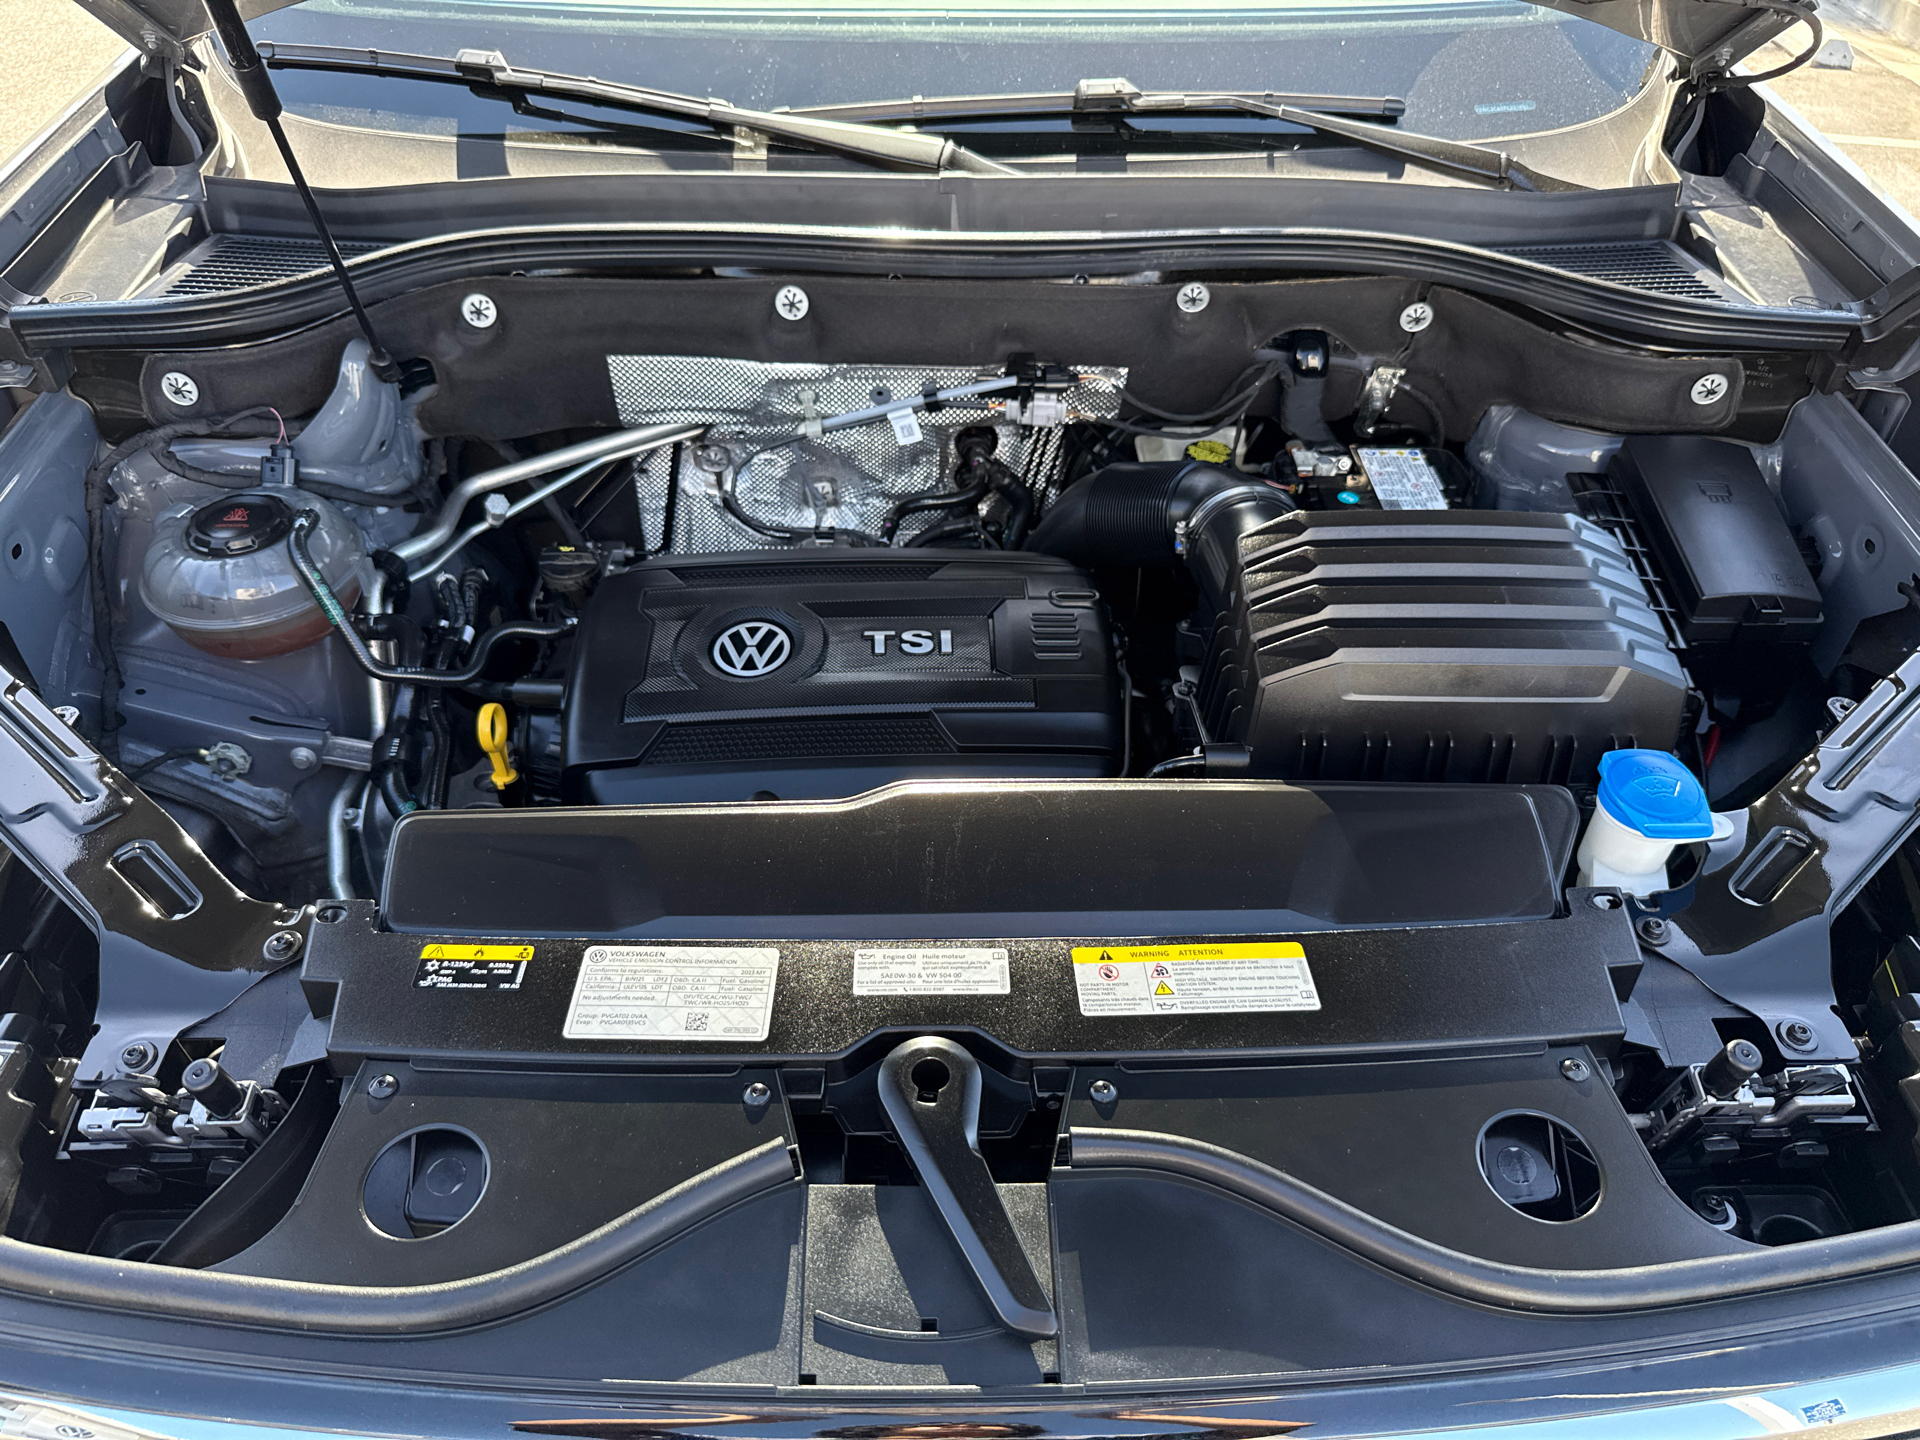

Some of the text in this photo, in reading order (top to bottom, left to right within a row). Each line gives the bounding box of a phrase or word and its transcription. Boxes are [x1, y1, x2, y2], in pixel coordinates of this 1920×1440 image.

[713, 621, 791, 677] VW
[864, 629, 952, 655] TSI
[442, 961, 475, 969] R-1234yf
